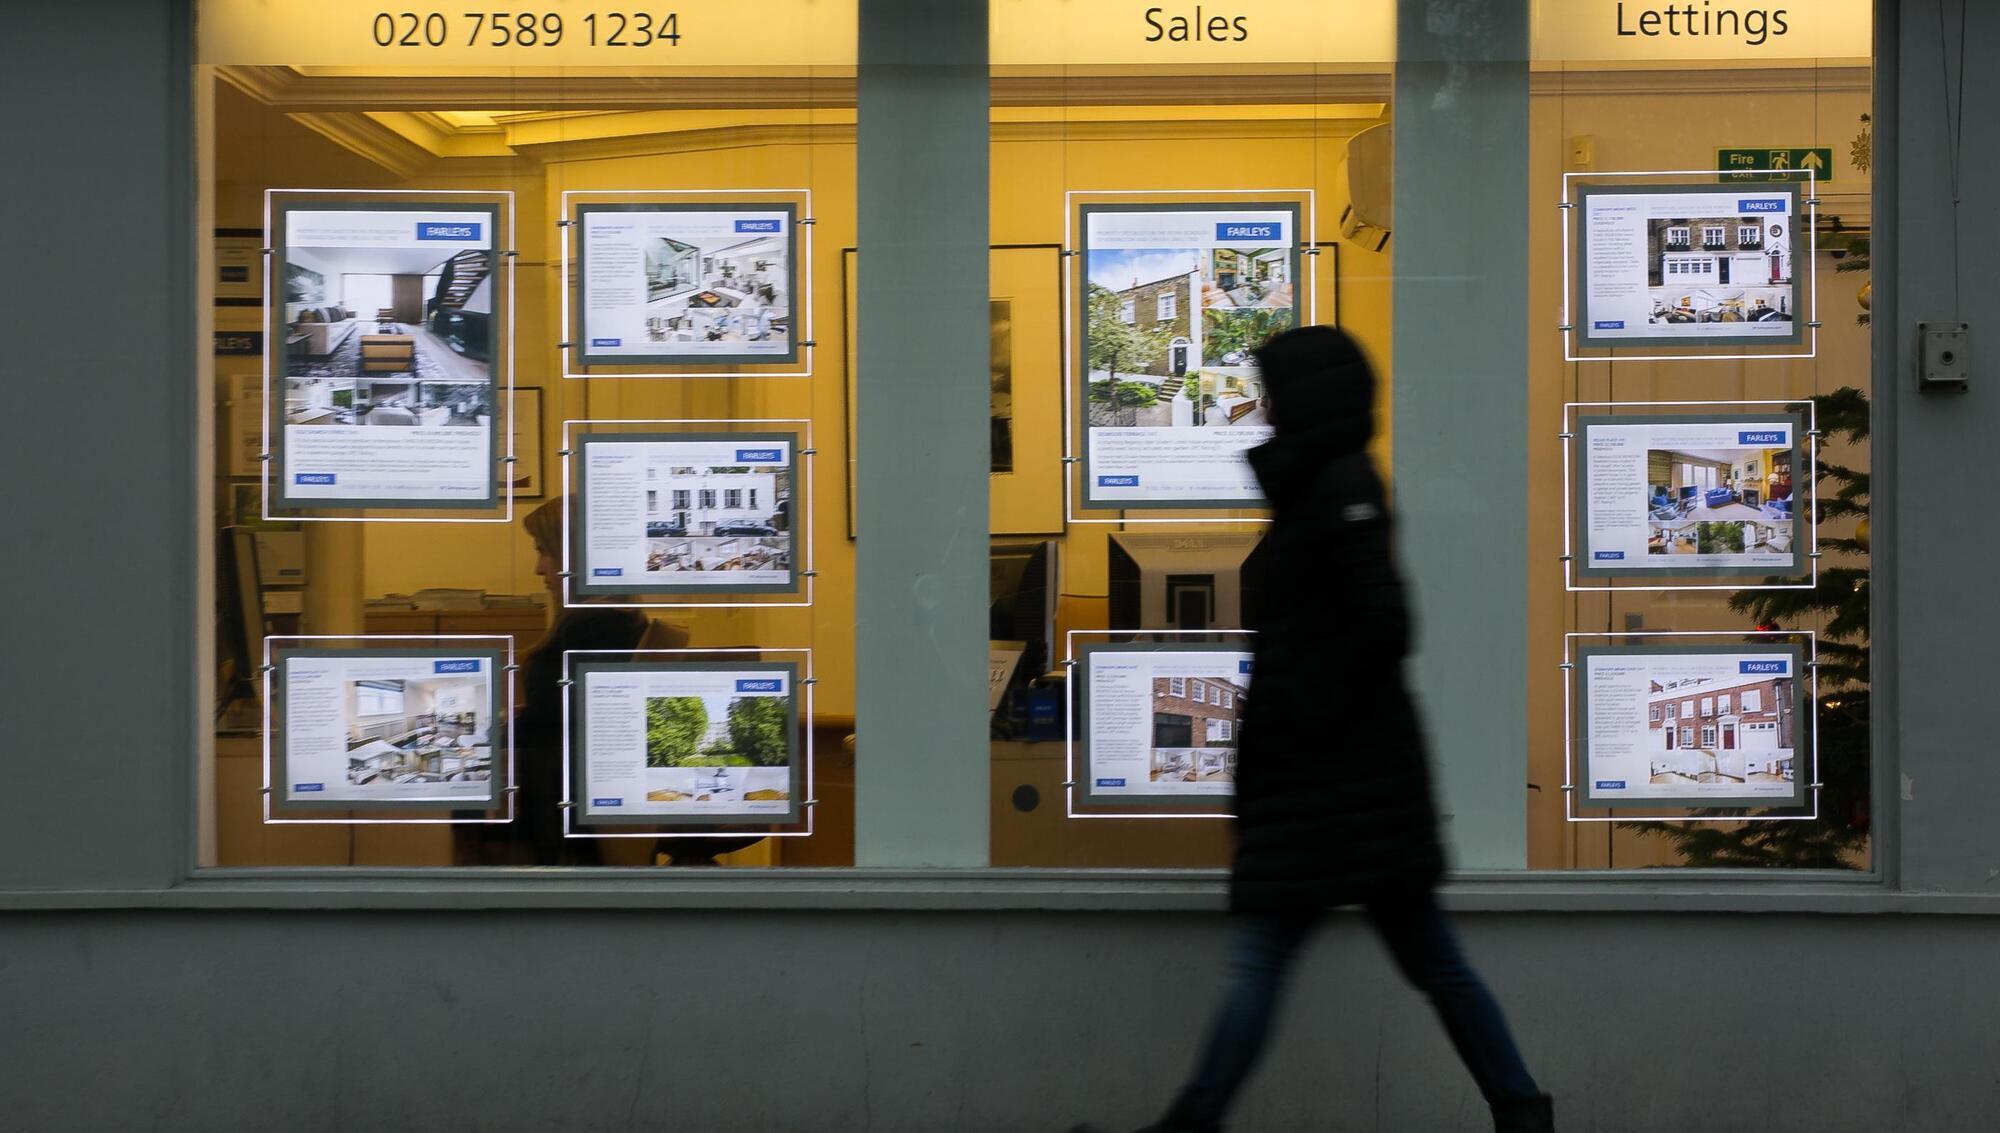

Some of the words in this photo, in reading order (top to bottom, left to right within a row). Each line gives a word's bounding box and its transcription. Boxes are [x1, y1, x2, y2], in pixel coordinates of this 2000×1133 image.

[1145, 5, 1248, 42] Sales
[1617, 0, 1788, 46] Lettings
[373, 12, 447, 47] 020
[464, 12, 563, 47] 7589
[584, 12, 681, 47] 1234
[1730, 154, 1754, 165] Fire
[1746, 202, 1778, 210] FARLEYS
[741, 222, 774, 230] FARLEYS
[426, 226, 472, 237] FARLEYS
[1226, 226, 1271, 237] FARLEYS
[1746, 434, 1778, 442] FARLEYS
[742, 452, 775, 460] FARLEYS
[440, 662, 473, 671] FARLEYS
[1747, 663, 1779, 672] FARLEYS
[742, 682, 775, 690] FARLEYS
